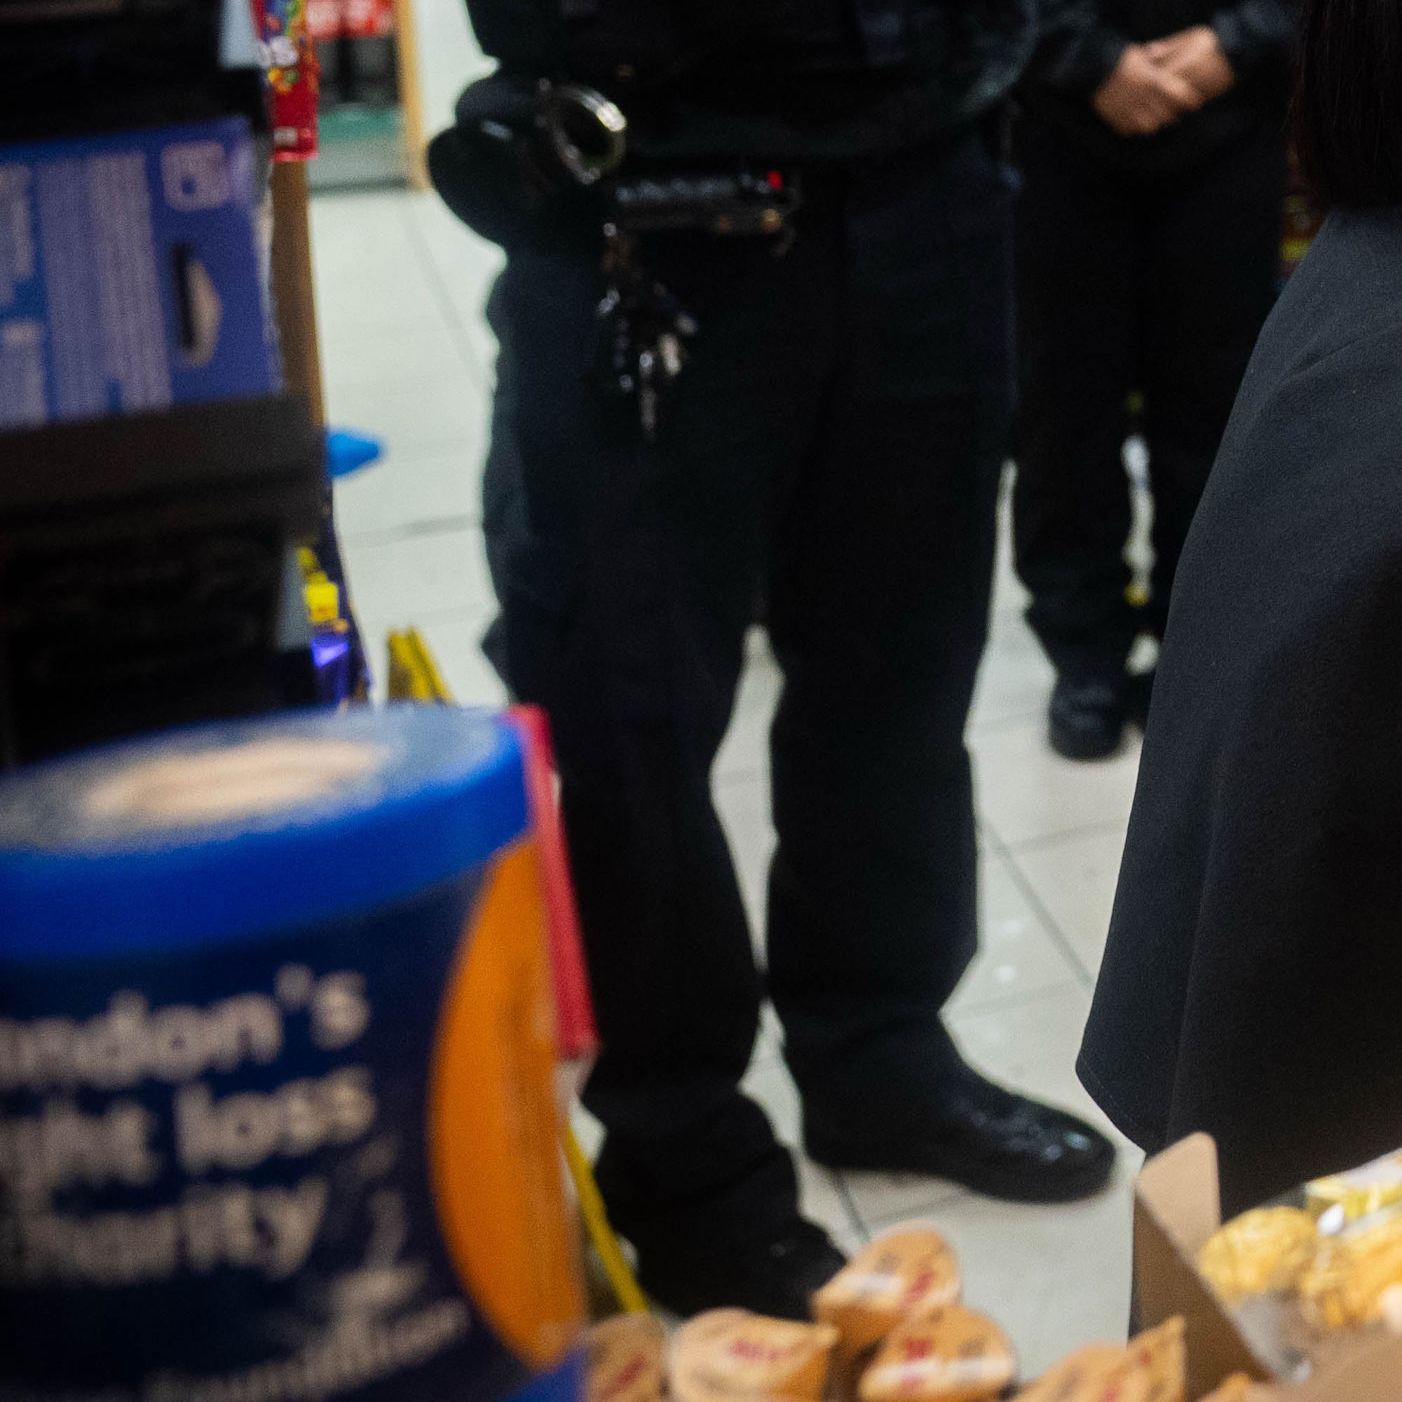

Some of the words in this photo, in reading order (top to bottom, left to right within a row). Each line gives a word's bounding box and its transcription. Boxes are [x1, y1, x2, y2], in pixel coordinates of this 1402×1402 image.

[0, 962, 371, 1091] ndon's
[174, 1064, 378, 1177] loss
[4, 1180, 328, 1290] harity
